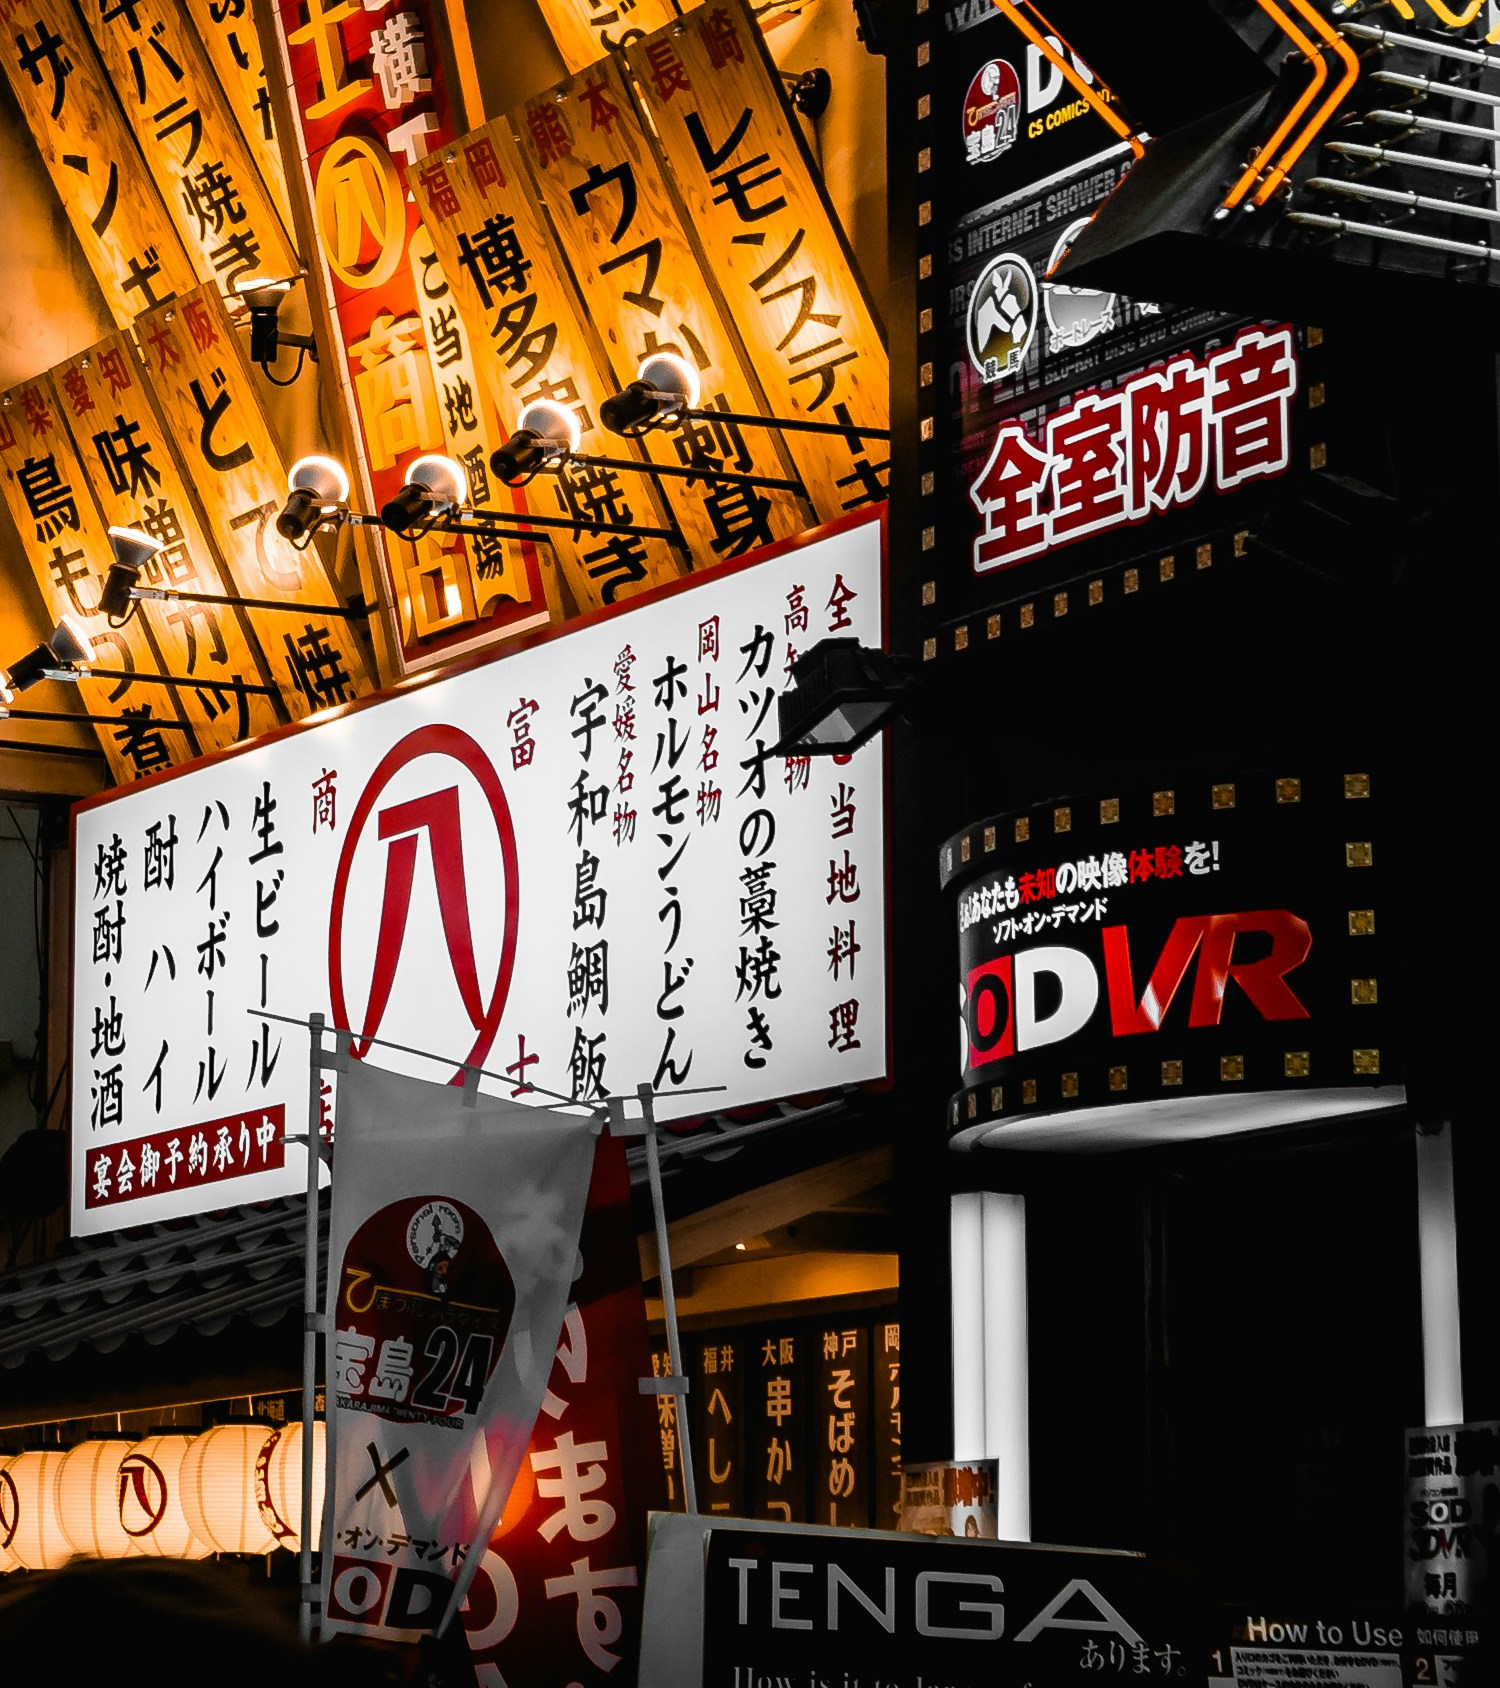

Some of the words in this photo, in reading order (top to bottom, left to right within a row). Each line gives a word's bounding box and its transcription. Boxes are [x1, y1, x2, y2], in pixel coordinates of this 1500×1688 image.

[644, 9, 746, 103] 長崎
[525, 76, 621, 168] 熊本
[1027, 119, 1045, 139] CS
[418, 135, 508, 223] 福岡
[62, 347, 131, 418] 愛知
[146, 297, 220, 374] 大阪
[970, 327, 1297, 572] 全室防音
[611, 642, 639, 848] 愛媛名物
[694, 614, 723, 825] 岡山名物
[823, 572, 863, 1056] 全当地料理
[566, 676, 609, 1100] 宇和島鯛飯
[651, 656, 695, 1089] ホルモンうどん
[141, 813, 178, 1115] 酎ハイ
[194, 798, 231, 1106] ハイボール
[248, 779, 284, 1091] 生ビール
[703, 1345, 735, 1374] 福井
[761, 1337, 795, 1368] 大阪
[823, 1329, 858, 1361] 神戸
[706, 1387, 734, 1511] へし
[727, 1556, 1146, 1646] TENGA
[1246, 1615, 1308, 1646] How
[1315, 1618, 1344, 1646] to
[1351, 1619, 1404, 1648] Use
